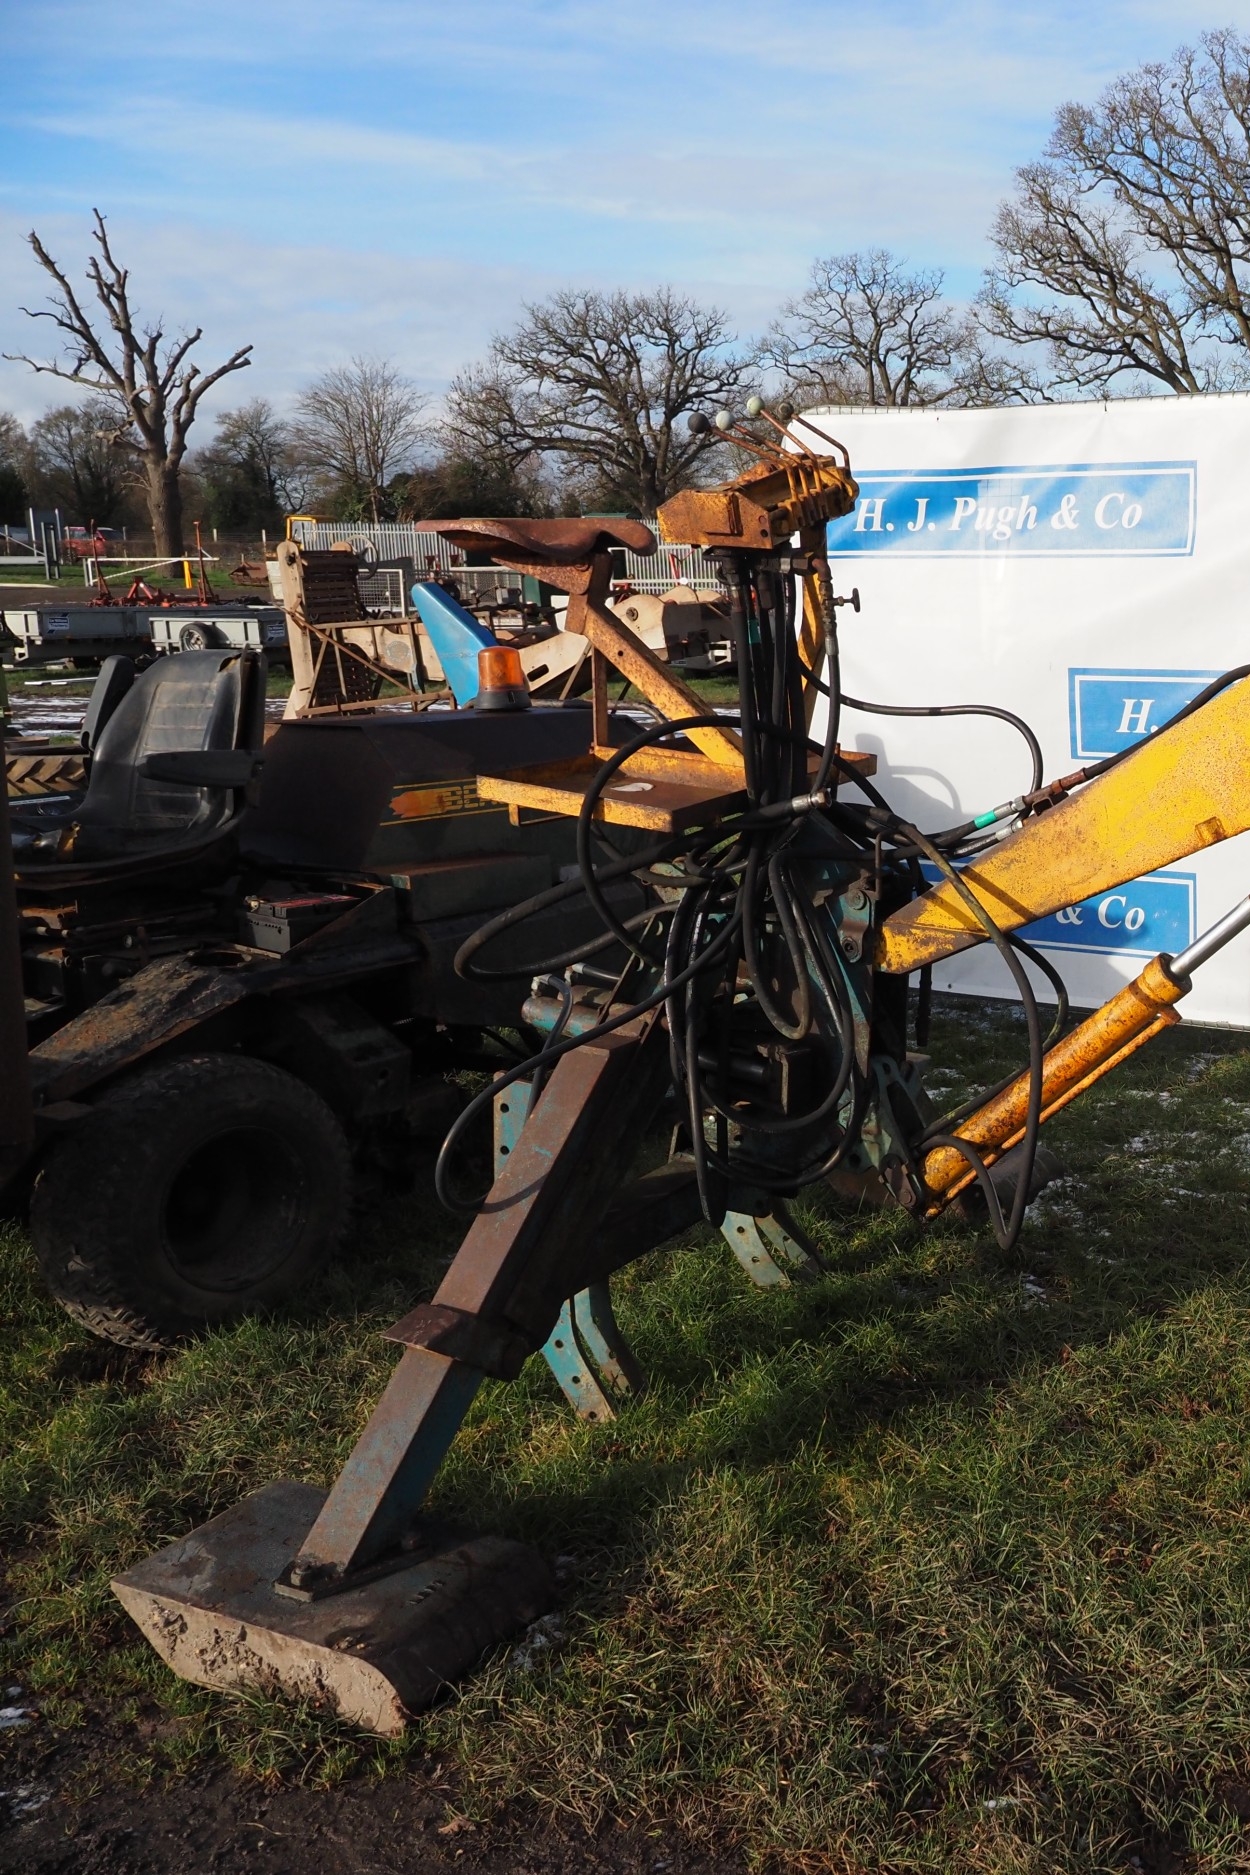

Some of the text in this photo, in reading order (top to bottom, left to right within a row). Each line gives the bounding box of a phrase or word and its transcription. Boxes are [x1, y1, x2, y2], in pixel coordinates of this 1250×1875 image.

[853, 492, 1143, 541] H. J. Pugh & Co
[1098, 895, 1145, 931] Co
